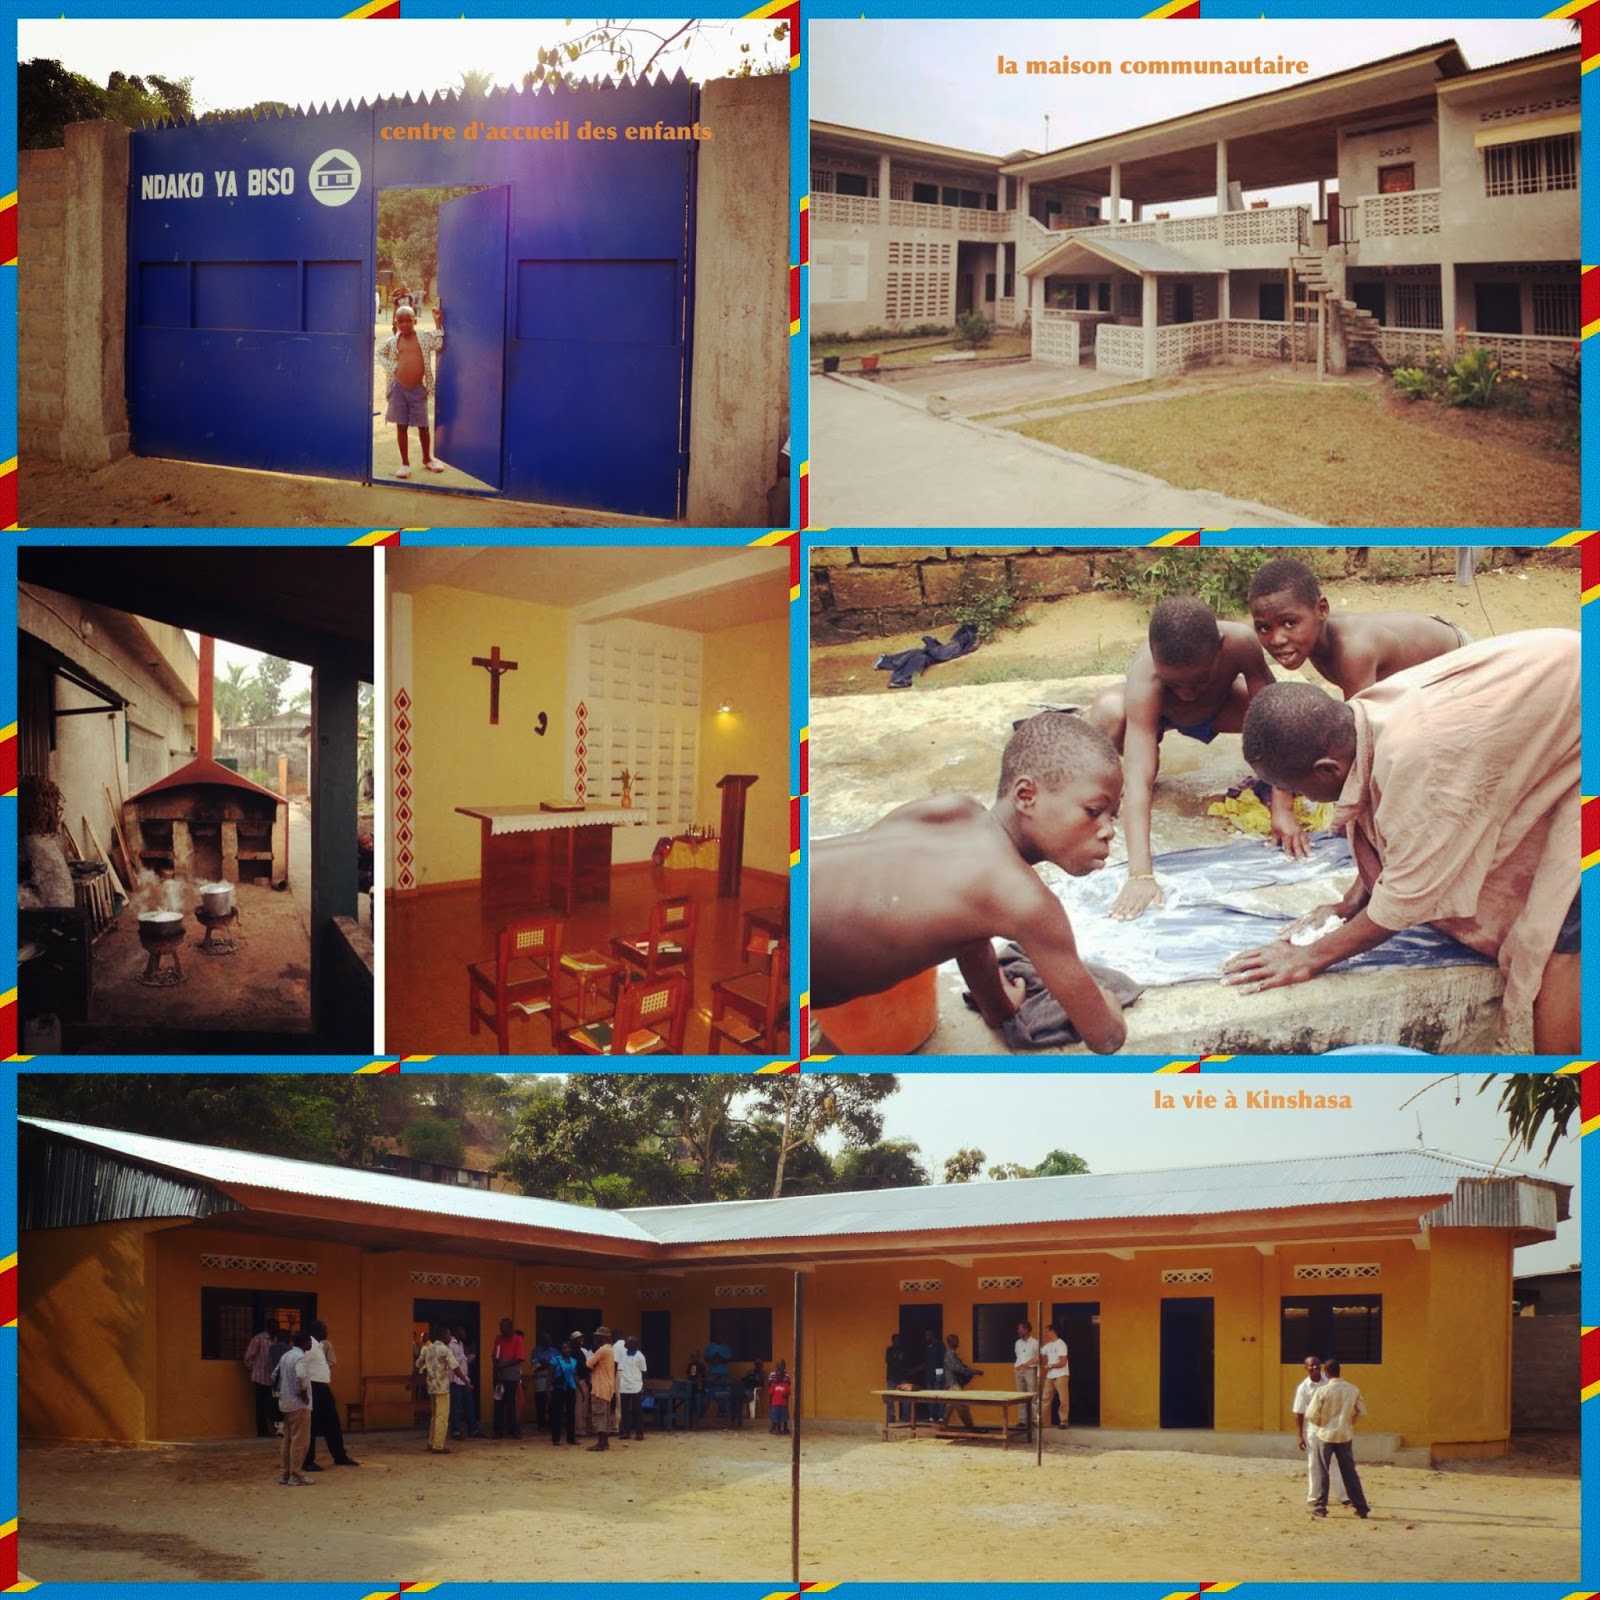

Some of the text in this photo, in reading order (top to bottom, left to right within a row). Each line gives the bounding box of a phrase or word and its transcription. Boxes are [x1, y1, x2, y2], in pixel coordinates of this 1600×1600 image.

[142, 167, 295, 200] NDAKO YA BISO
